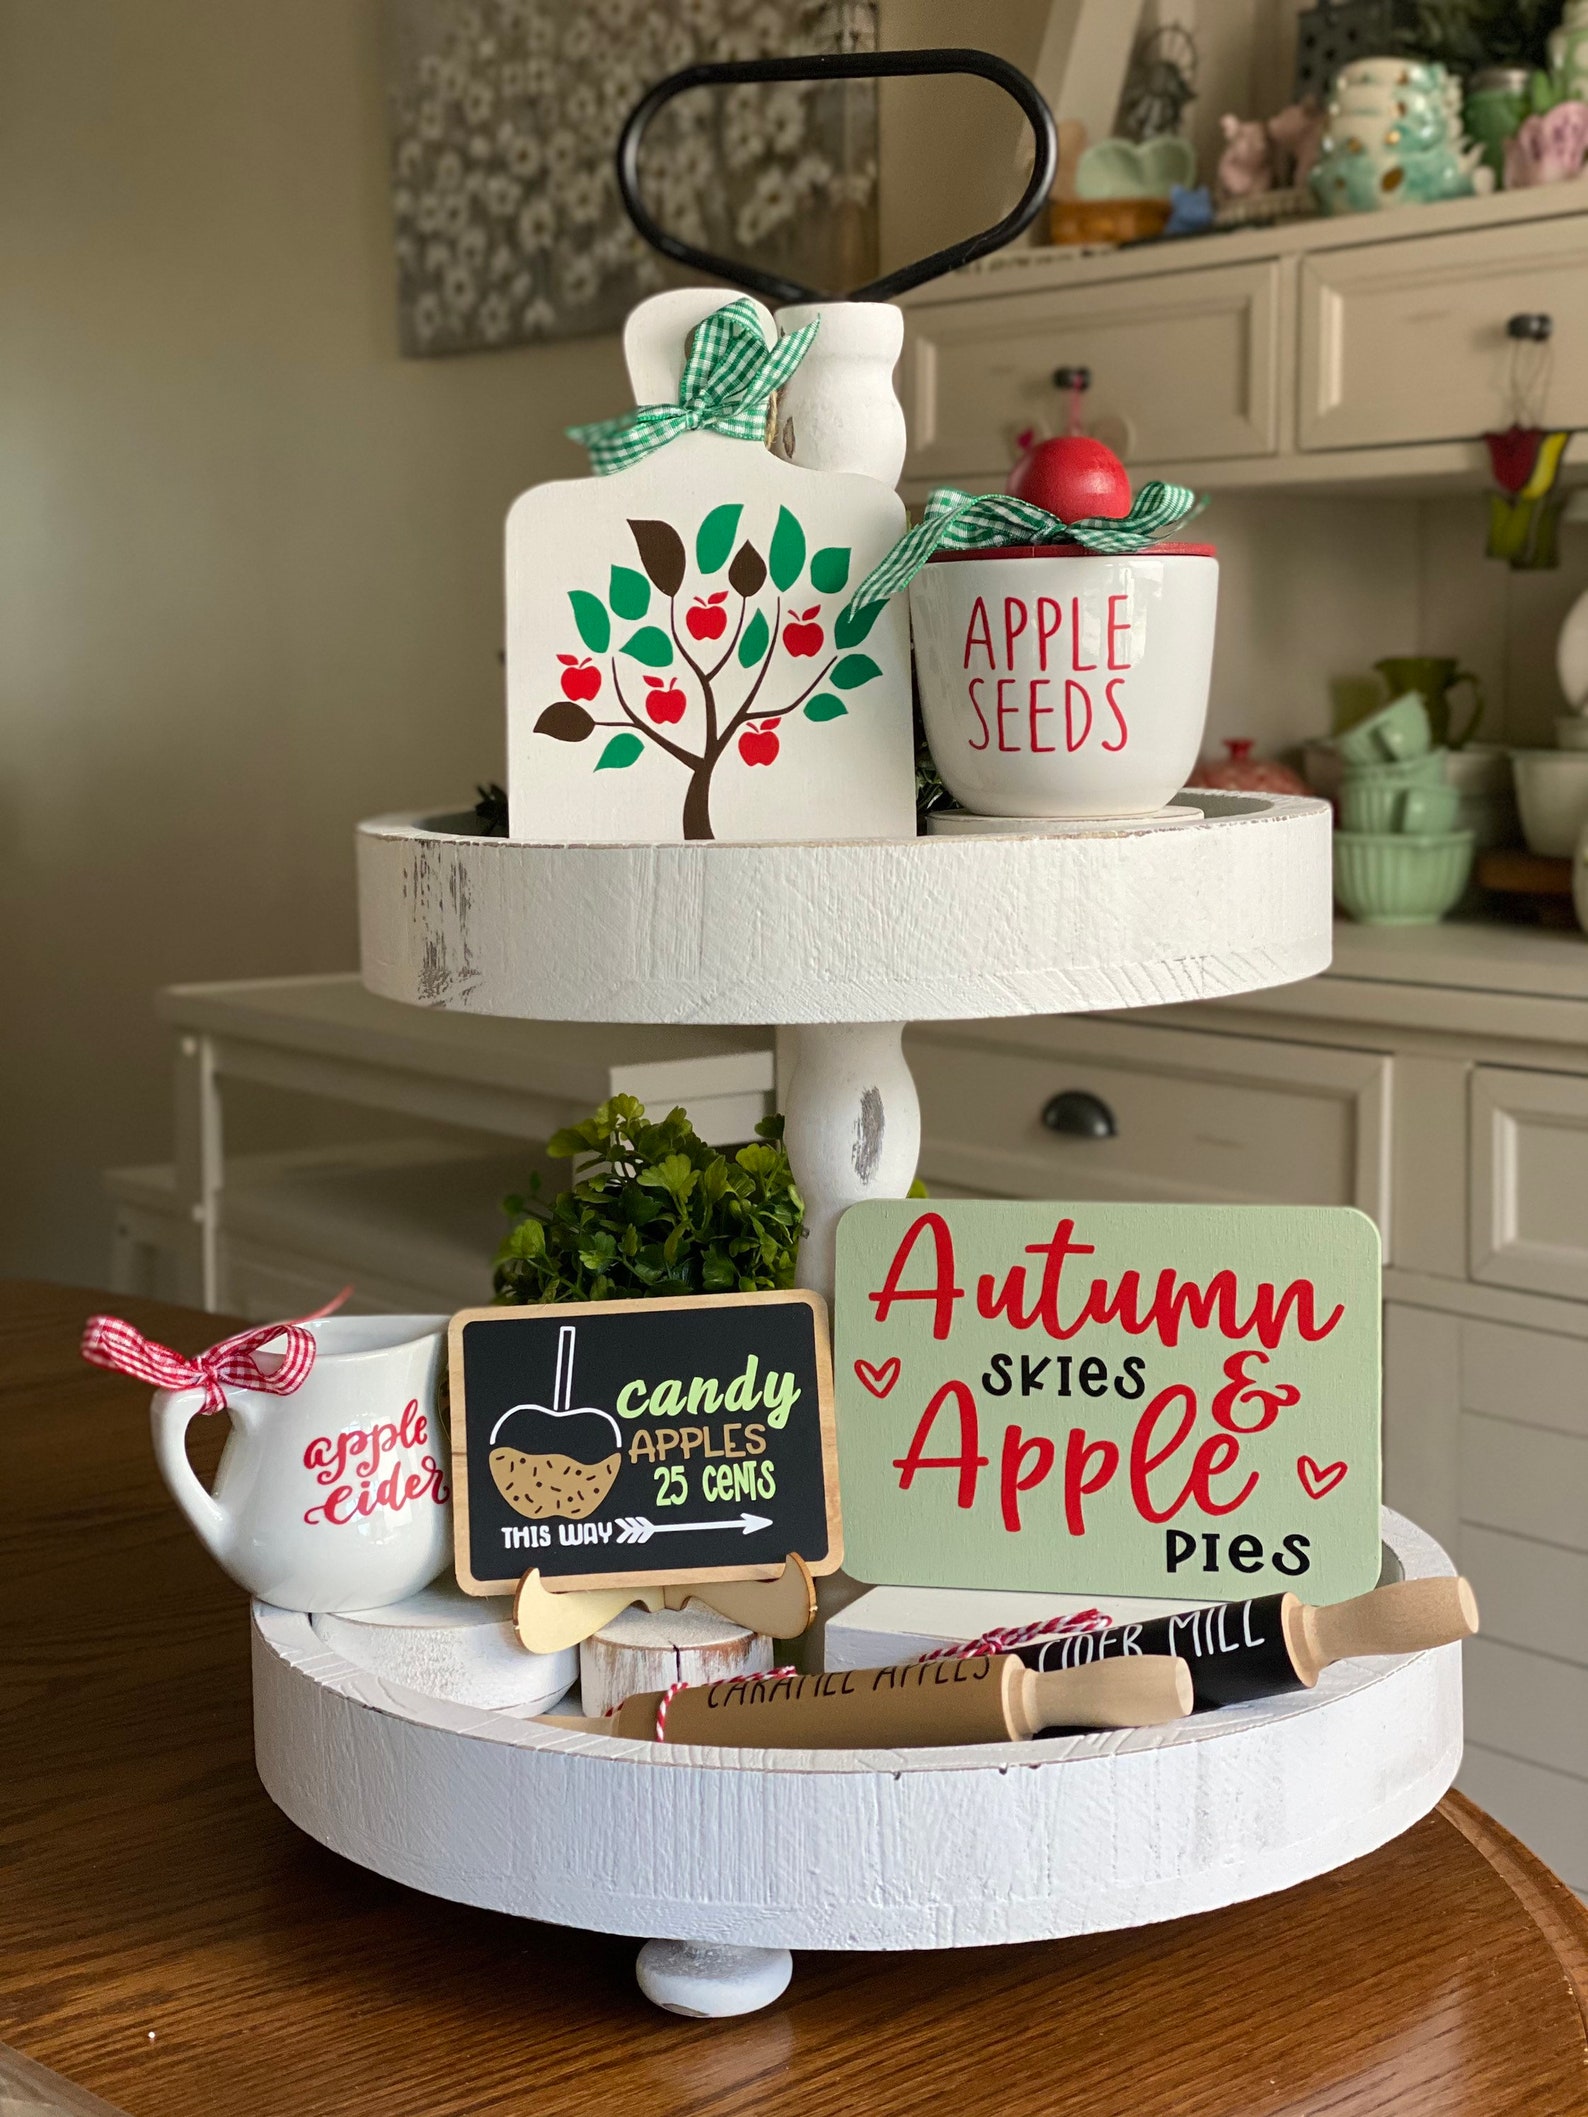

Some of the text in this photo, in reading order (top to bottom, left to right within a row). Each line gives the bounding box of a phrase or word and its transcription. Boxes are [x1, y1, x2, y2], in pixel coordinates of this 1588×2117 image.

[964, 596, 1131, 671] APPLE
[968, 678, 1128, 752] SEEDS
[868, 1212, 1345, 1349] Autumn
[616, 1354, 802, 1430] candy
[1211, 1350, 1301, 1433] &
[303, 1399, 428, 1485] apple
[628, 1423, 767, 1464] APPLES
[892, 1380, 1260, 1536] Apple
[653, 1465, 689, 1507] 25
[501, 1523, 613, 1549] THIS WAY
[1168, 1600, 1265, 1658] MILL
